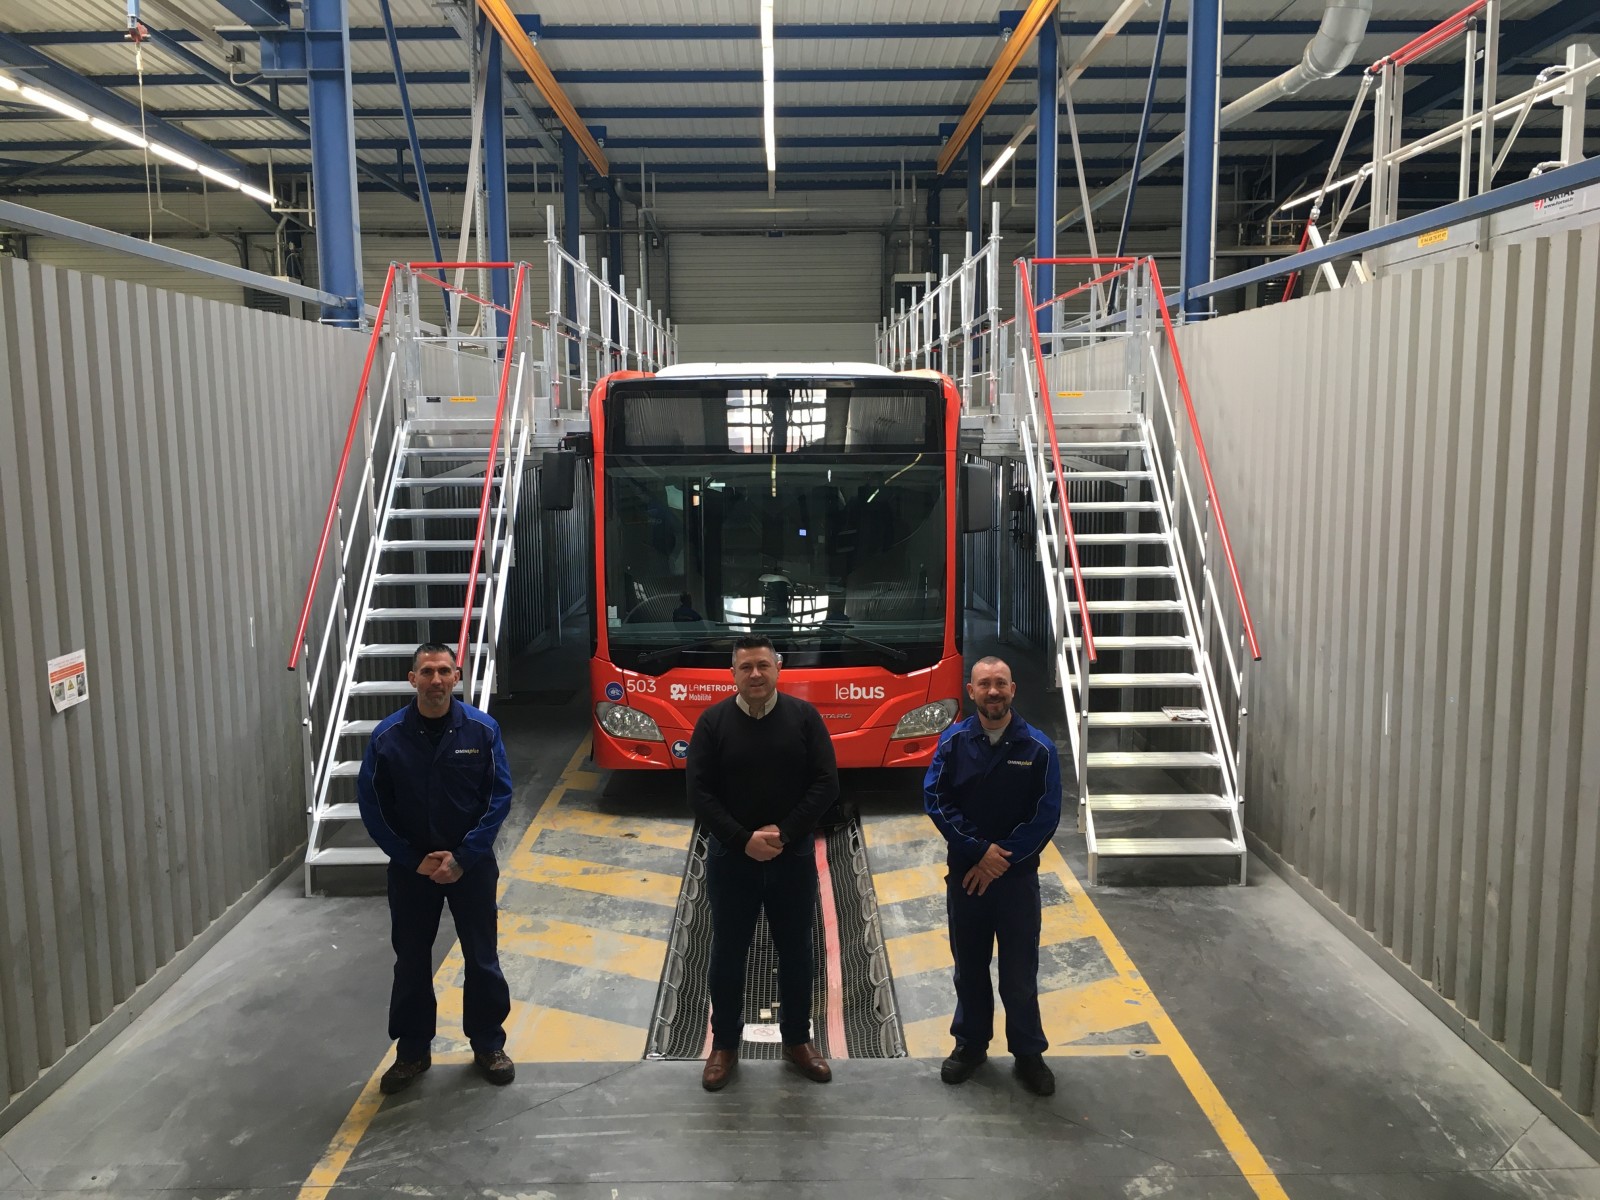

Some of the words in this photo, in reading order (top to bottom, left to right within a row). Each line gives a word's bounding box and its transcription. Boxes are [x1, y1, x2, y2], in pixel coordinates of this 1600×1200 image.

[626, 679, 657, 693] 503
[688, 684, 738, 692] LAMETROPO
[835, 683, 885, 700] lebus
[688, 693, 712, 701] Mobilité
